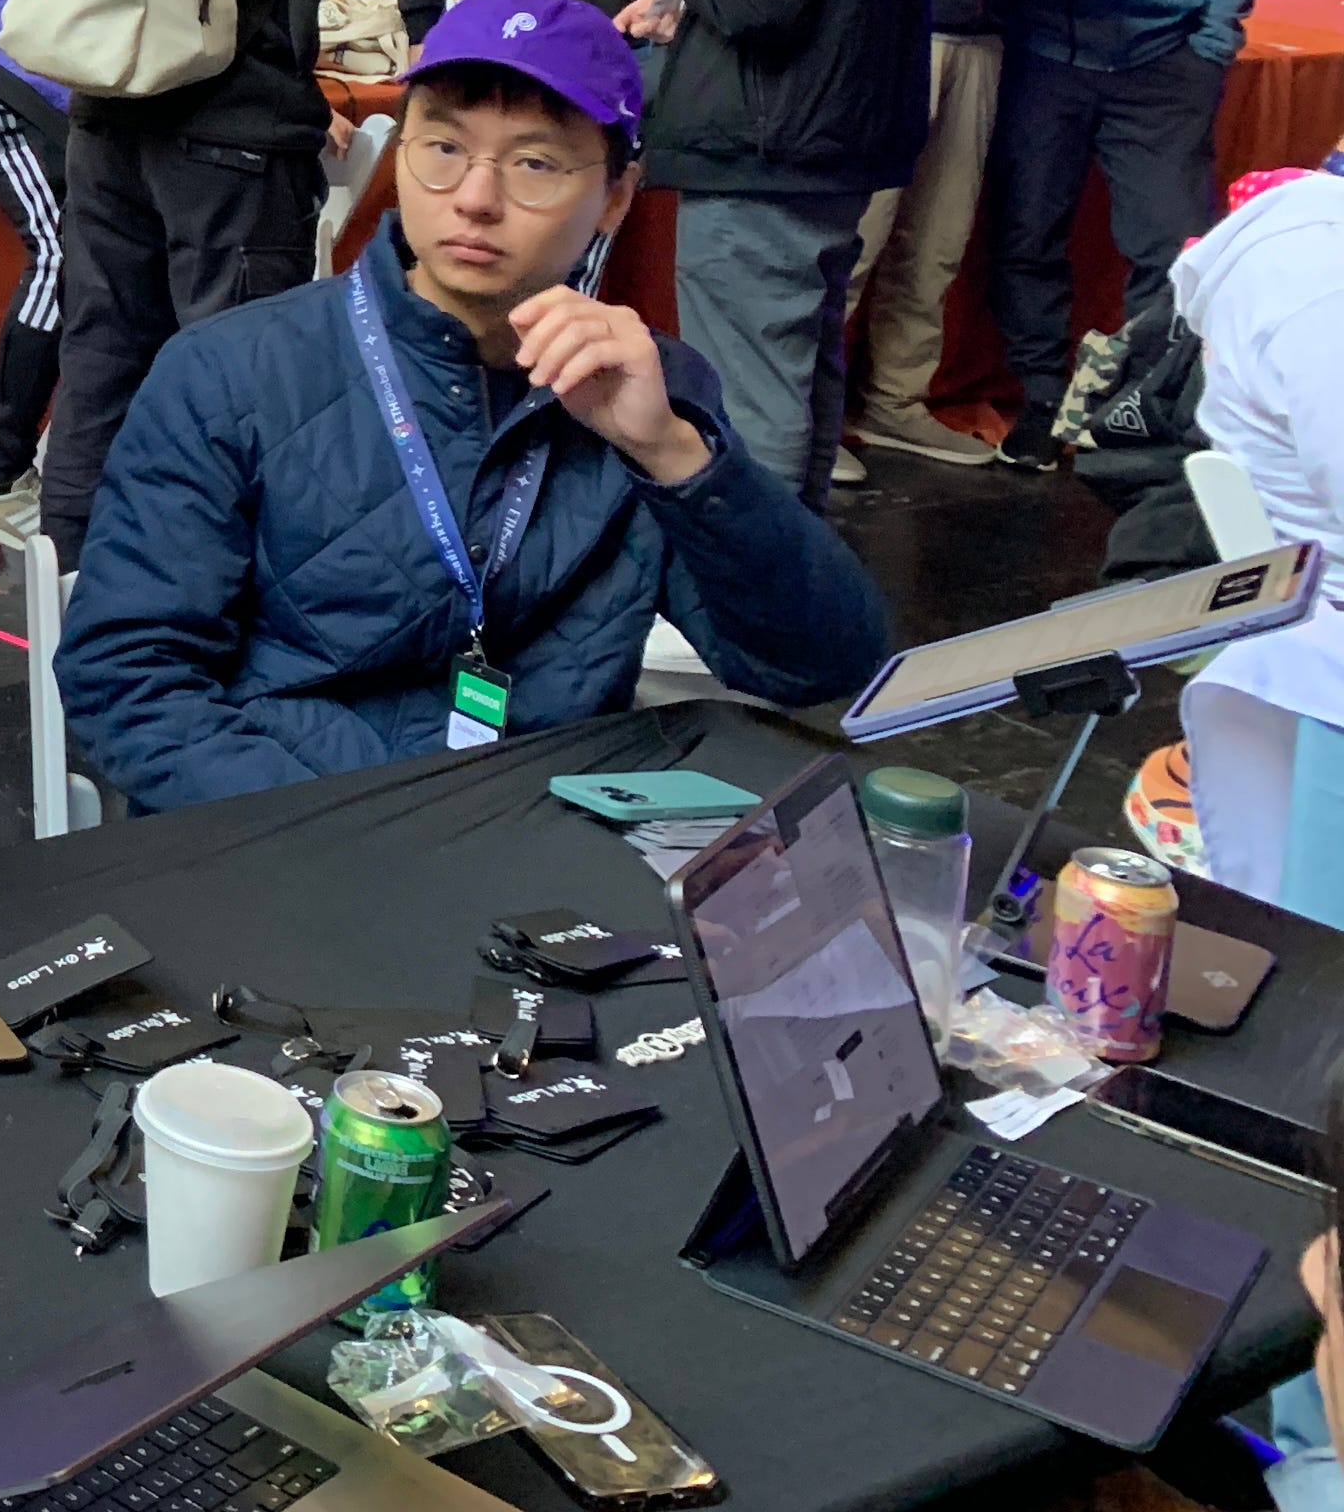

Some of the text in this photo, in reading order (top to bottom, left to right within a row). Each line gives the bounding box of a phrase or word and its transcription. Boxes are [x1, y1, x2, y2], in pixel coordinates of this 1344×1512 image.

[374, 365, 404, 425] ETHGlobal
[1066, 913, 1115, 974] La
[7, 964, 54, 990] Labs
